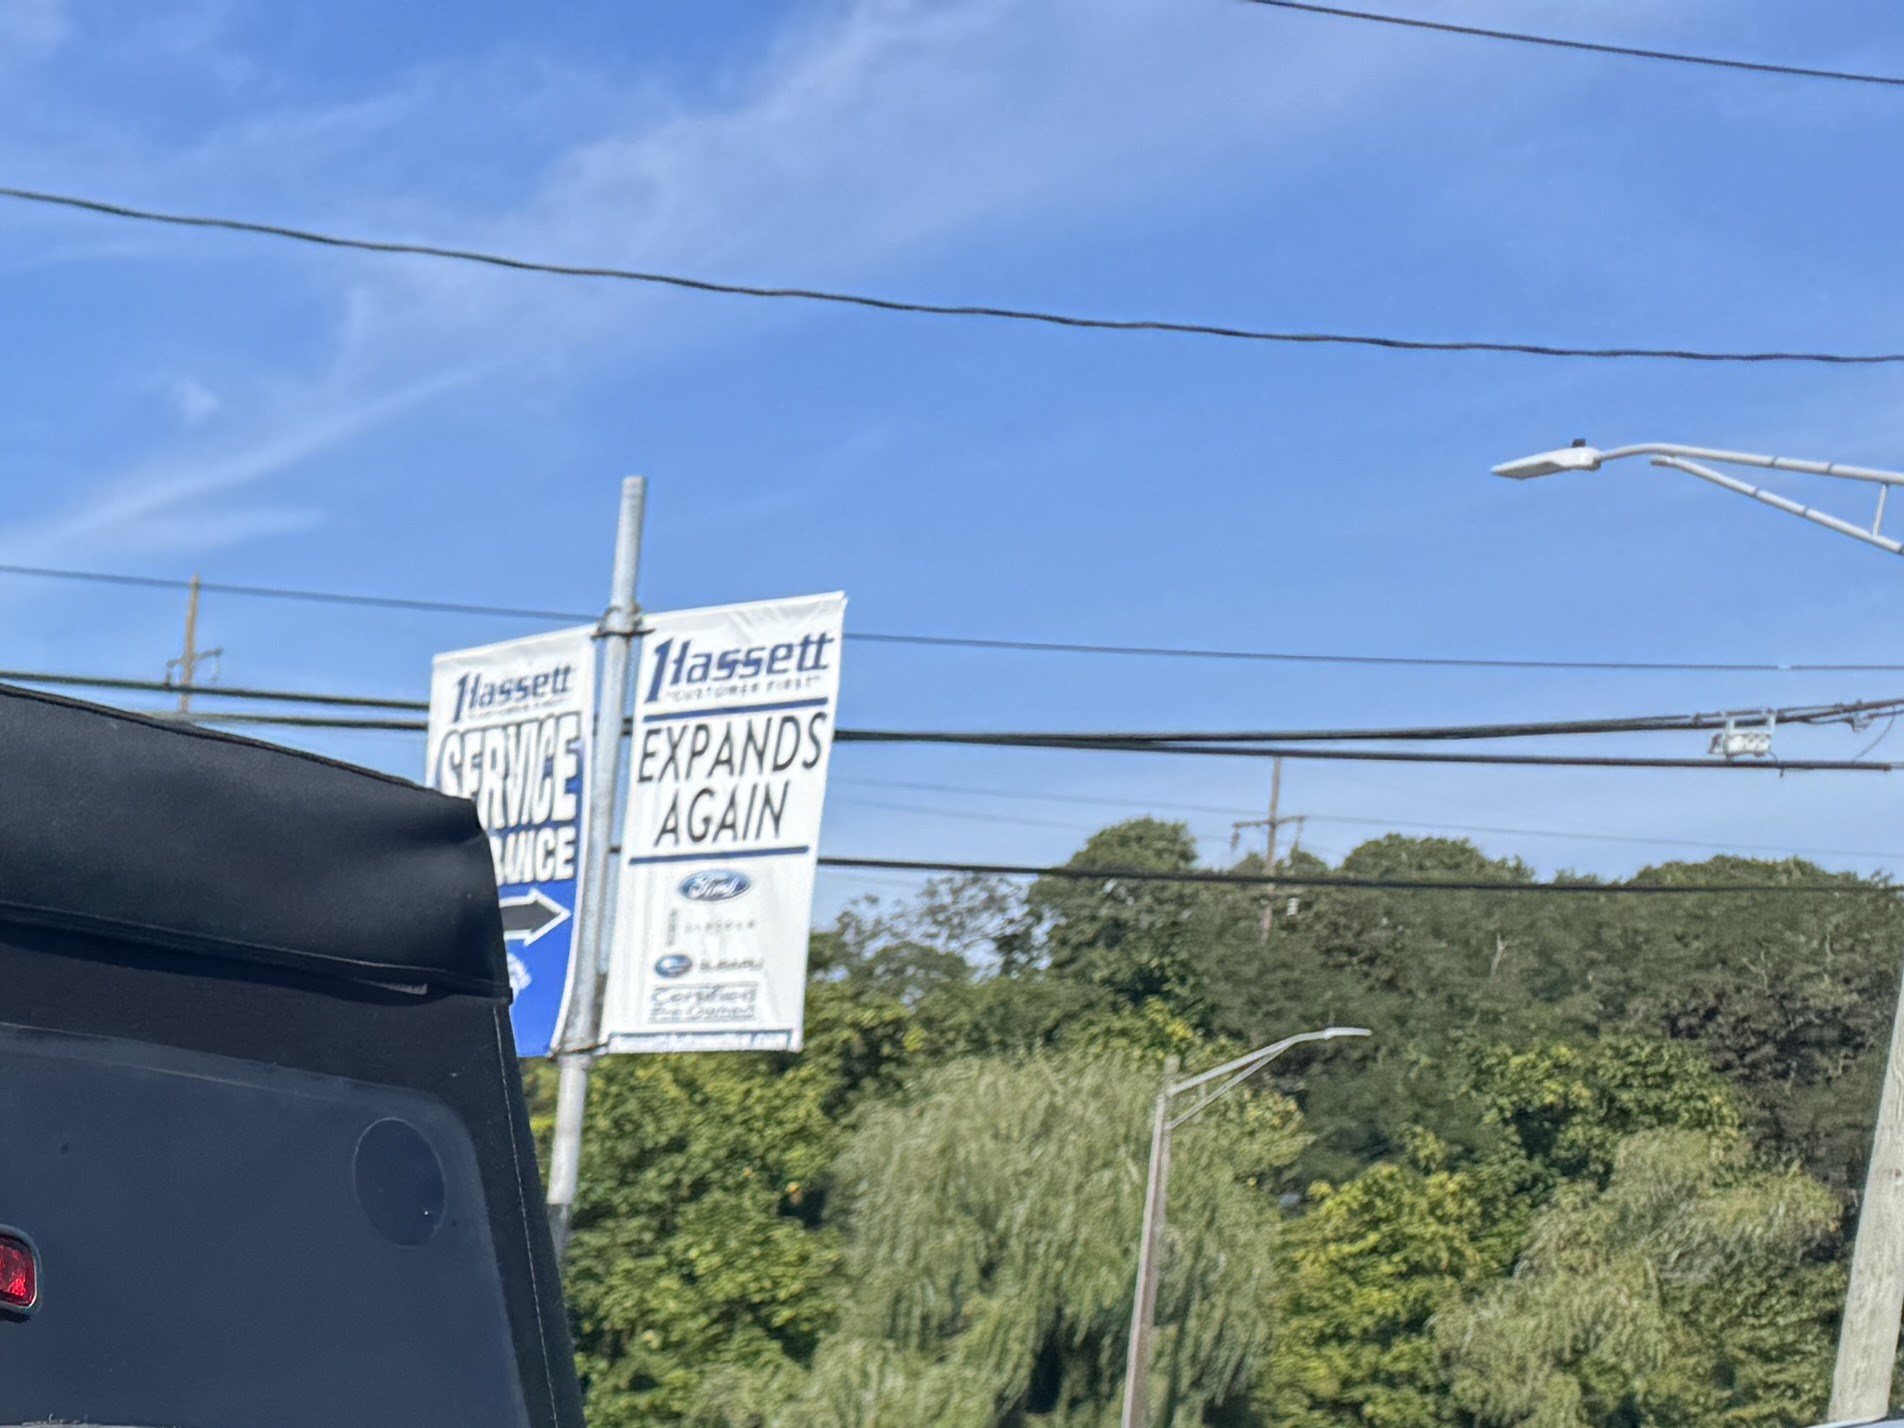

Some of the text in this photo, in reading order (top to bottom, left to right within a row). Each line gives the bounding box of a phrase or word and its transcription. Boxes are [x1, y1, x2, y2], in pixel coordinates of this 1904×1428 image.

[438, 711, 583, 830] SERVICE
[638, 711, 828, 783] EXPANDS
[653, 780, 790, 847] AGAIN
